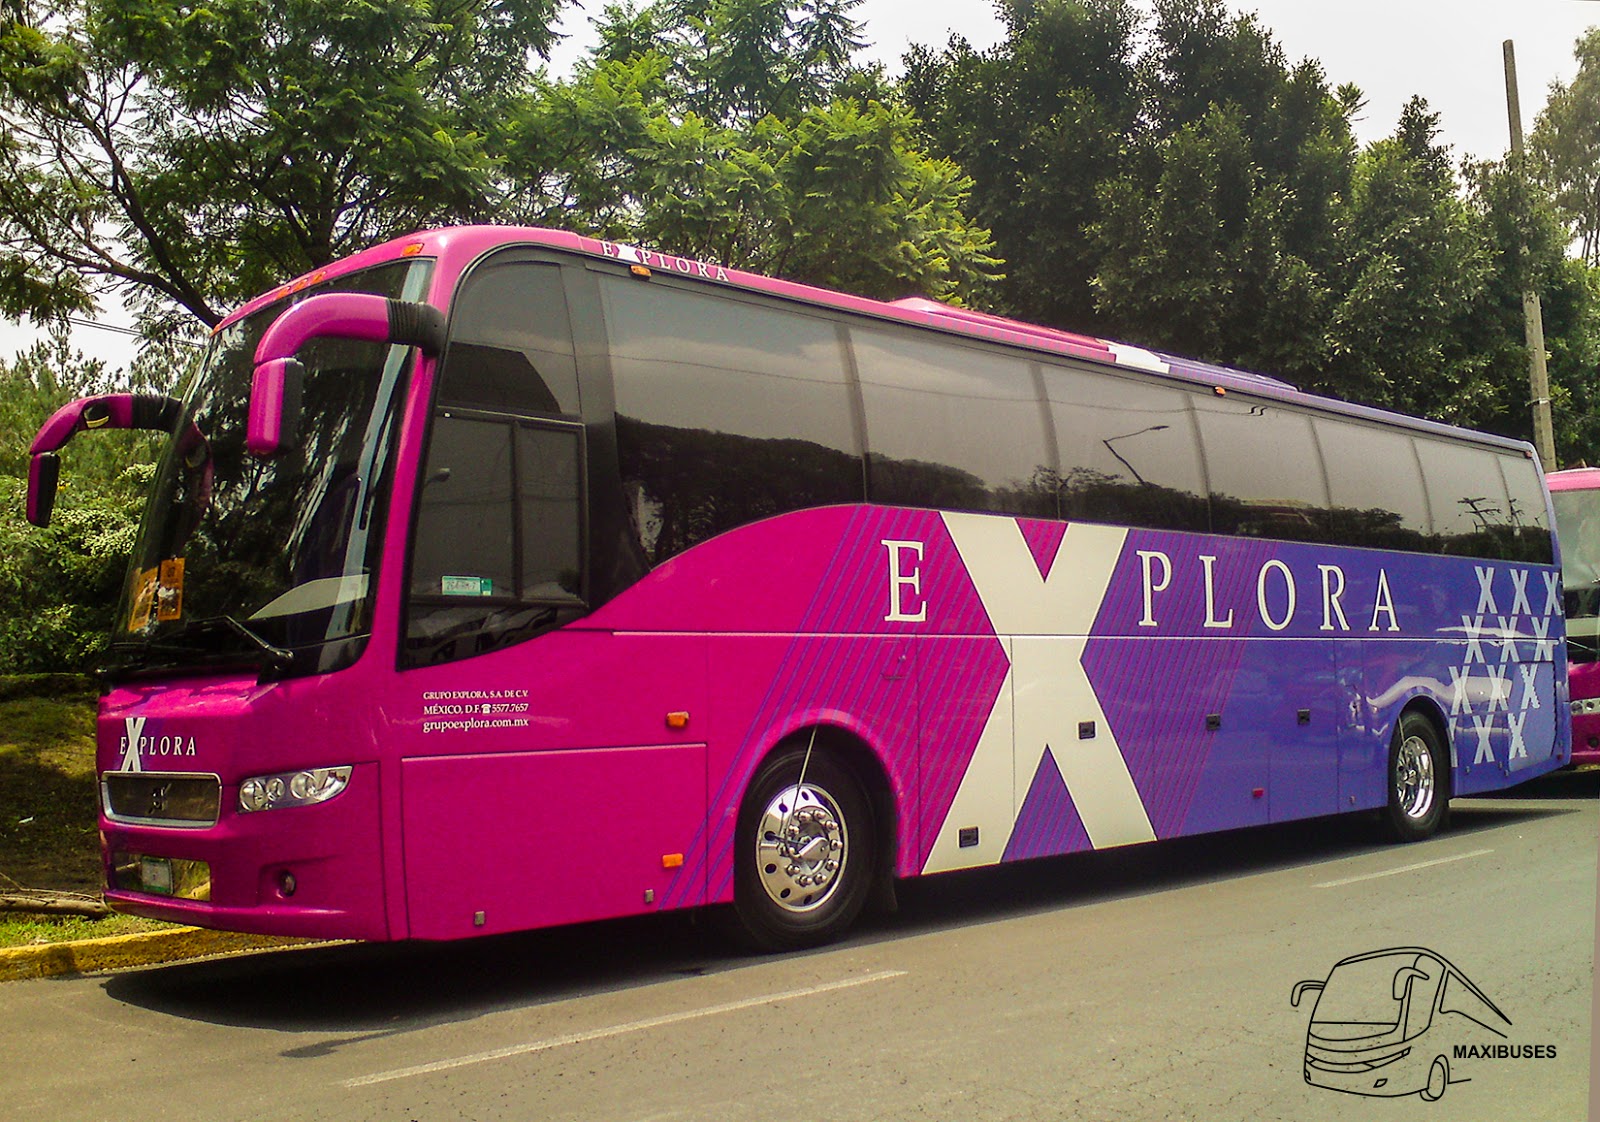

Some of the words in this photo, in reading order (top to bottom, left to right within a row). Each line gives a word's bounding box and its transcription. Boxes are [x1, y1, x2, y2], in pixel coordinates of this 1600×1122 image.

[423, 691, 451, 700] GRUPO
[504, 690, 515, 698] DE
[880, 511, 1401, 875] EXPLORA
[423, 717, 529, 732] grupoexplora.com.mx
[119, 717, 197, 772] EXPLORA
